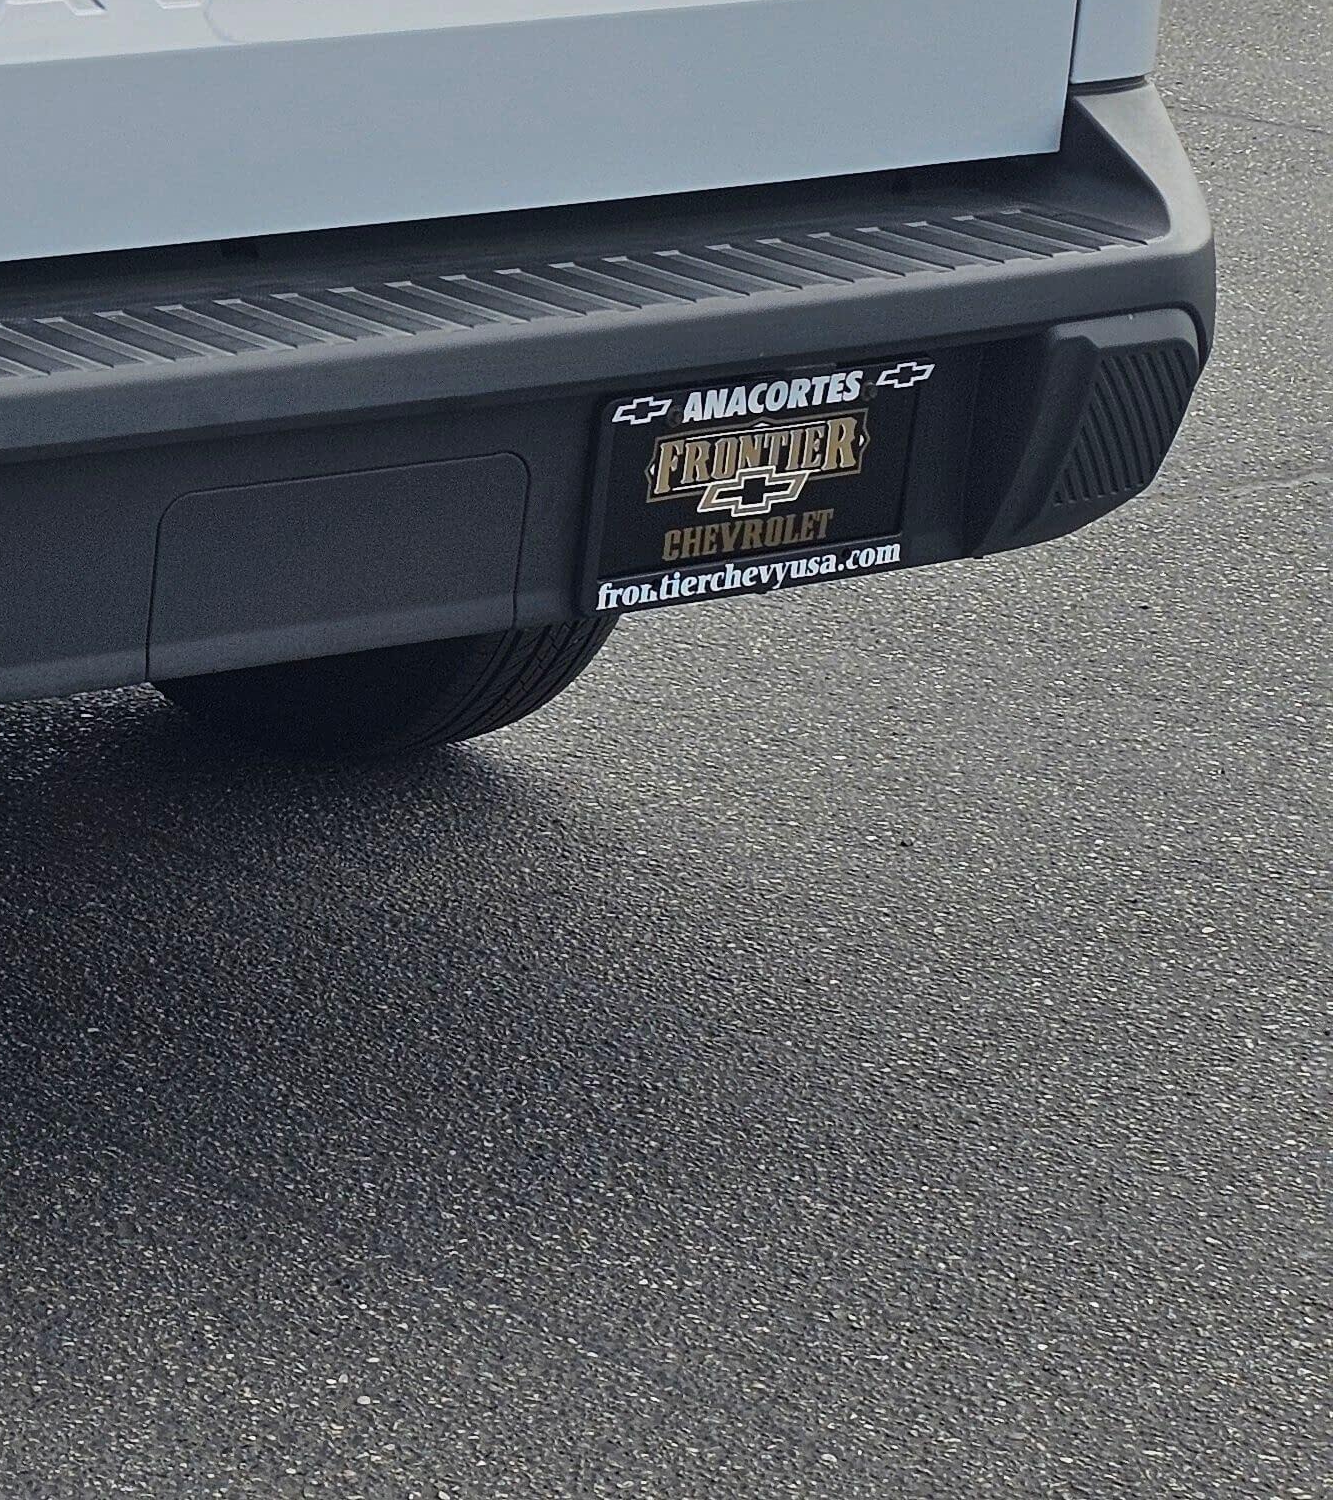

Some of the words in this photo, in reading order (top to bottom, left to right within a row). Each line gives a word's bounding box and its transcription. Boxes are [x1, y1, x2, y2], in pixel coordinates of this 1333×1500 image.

[682, 371, 864, 423] ANACORTES
[653, 416, 859, 495] FRONTIER
[661, 508, 835, 562] CHEVROLET
[595, 543, 901, 611] frontierchevyusa.com
